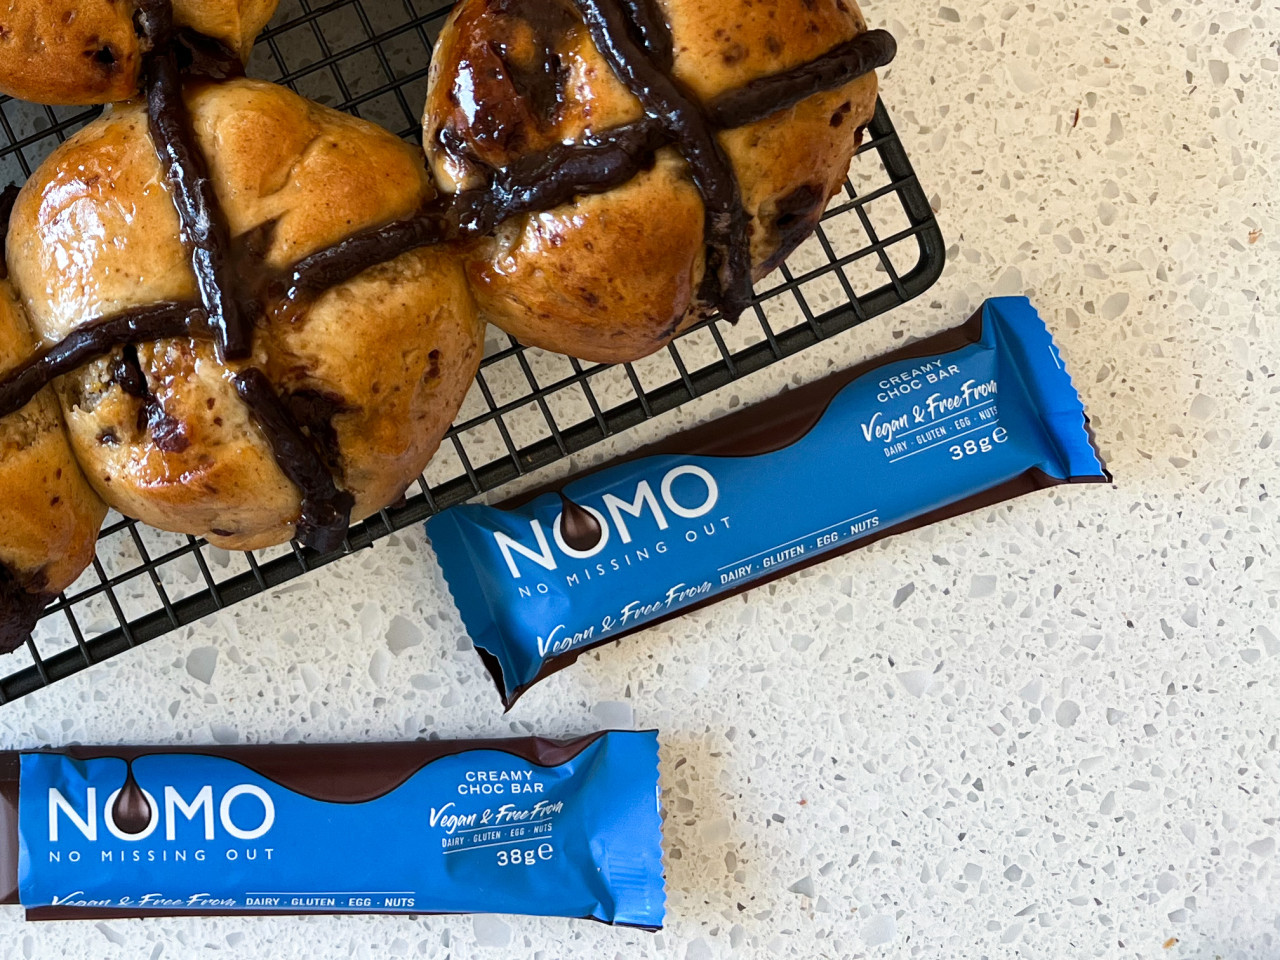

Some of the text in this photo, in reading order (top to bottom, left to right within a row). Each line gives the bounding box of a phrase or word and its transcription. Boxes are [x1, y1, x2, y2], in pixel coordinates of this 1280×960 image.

[877, 364, 960, 403] CHOC BAR
[879, 359, 942, 390] CREAMY
[861, 412, 909, 443] Vegan
[912, 405, 925, 424] &
[883, 406, 998, 458] DAIRY GLUTEN EGG NUTS
[493, 464, 718, 579] NOMO
[518, 516, 730, 598] NO MISSING OUT
[537, 624, 594, 657] Vegan
[601, 615, 616, 633] &
[720, 564, 752, 585] DAIRY
[763, 544, 804, 568] GLUTEN
[816, 531, 839, 548] EGG
[850, 516, 880, 535] NUTS
[457, 783, 544, 795] CHOC BAR
[465, 770, 533, 782] CREAMY
[48, 784, 275, 841] NOMO
[429, 802, 477, 834] Vegan
[480, 809, 494, 824] &
[442, 823, 553, 848] DAIRY GLUTEN EGG NUTS
[49, 848, 274, 863] NO MISSING OUT
[117, 896, 135, 907] &
[246, 897, 280, 907] DAIRY
[291, 897, 335, 907] GLUTEN
[348, 897, 371, 907] EGG
[384, 897, 415, 908] NUTS
